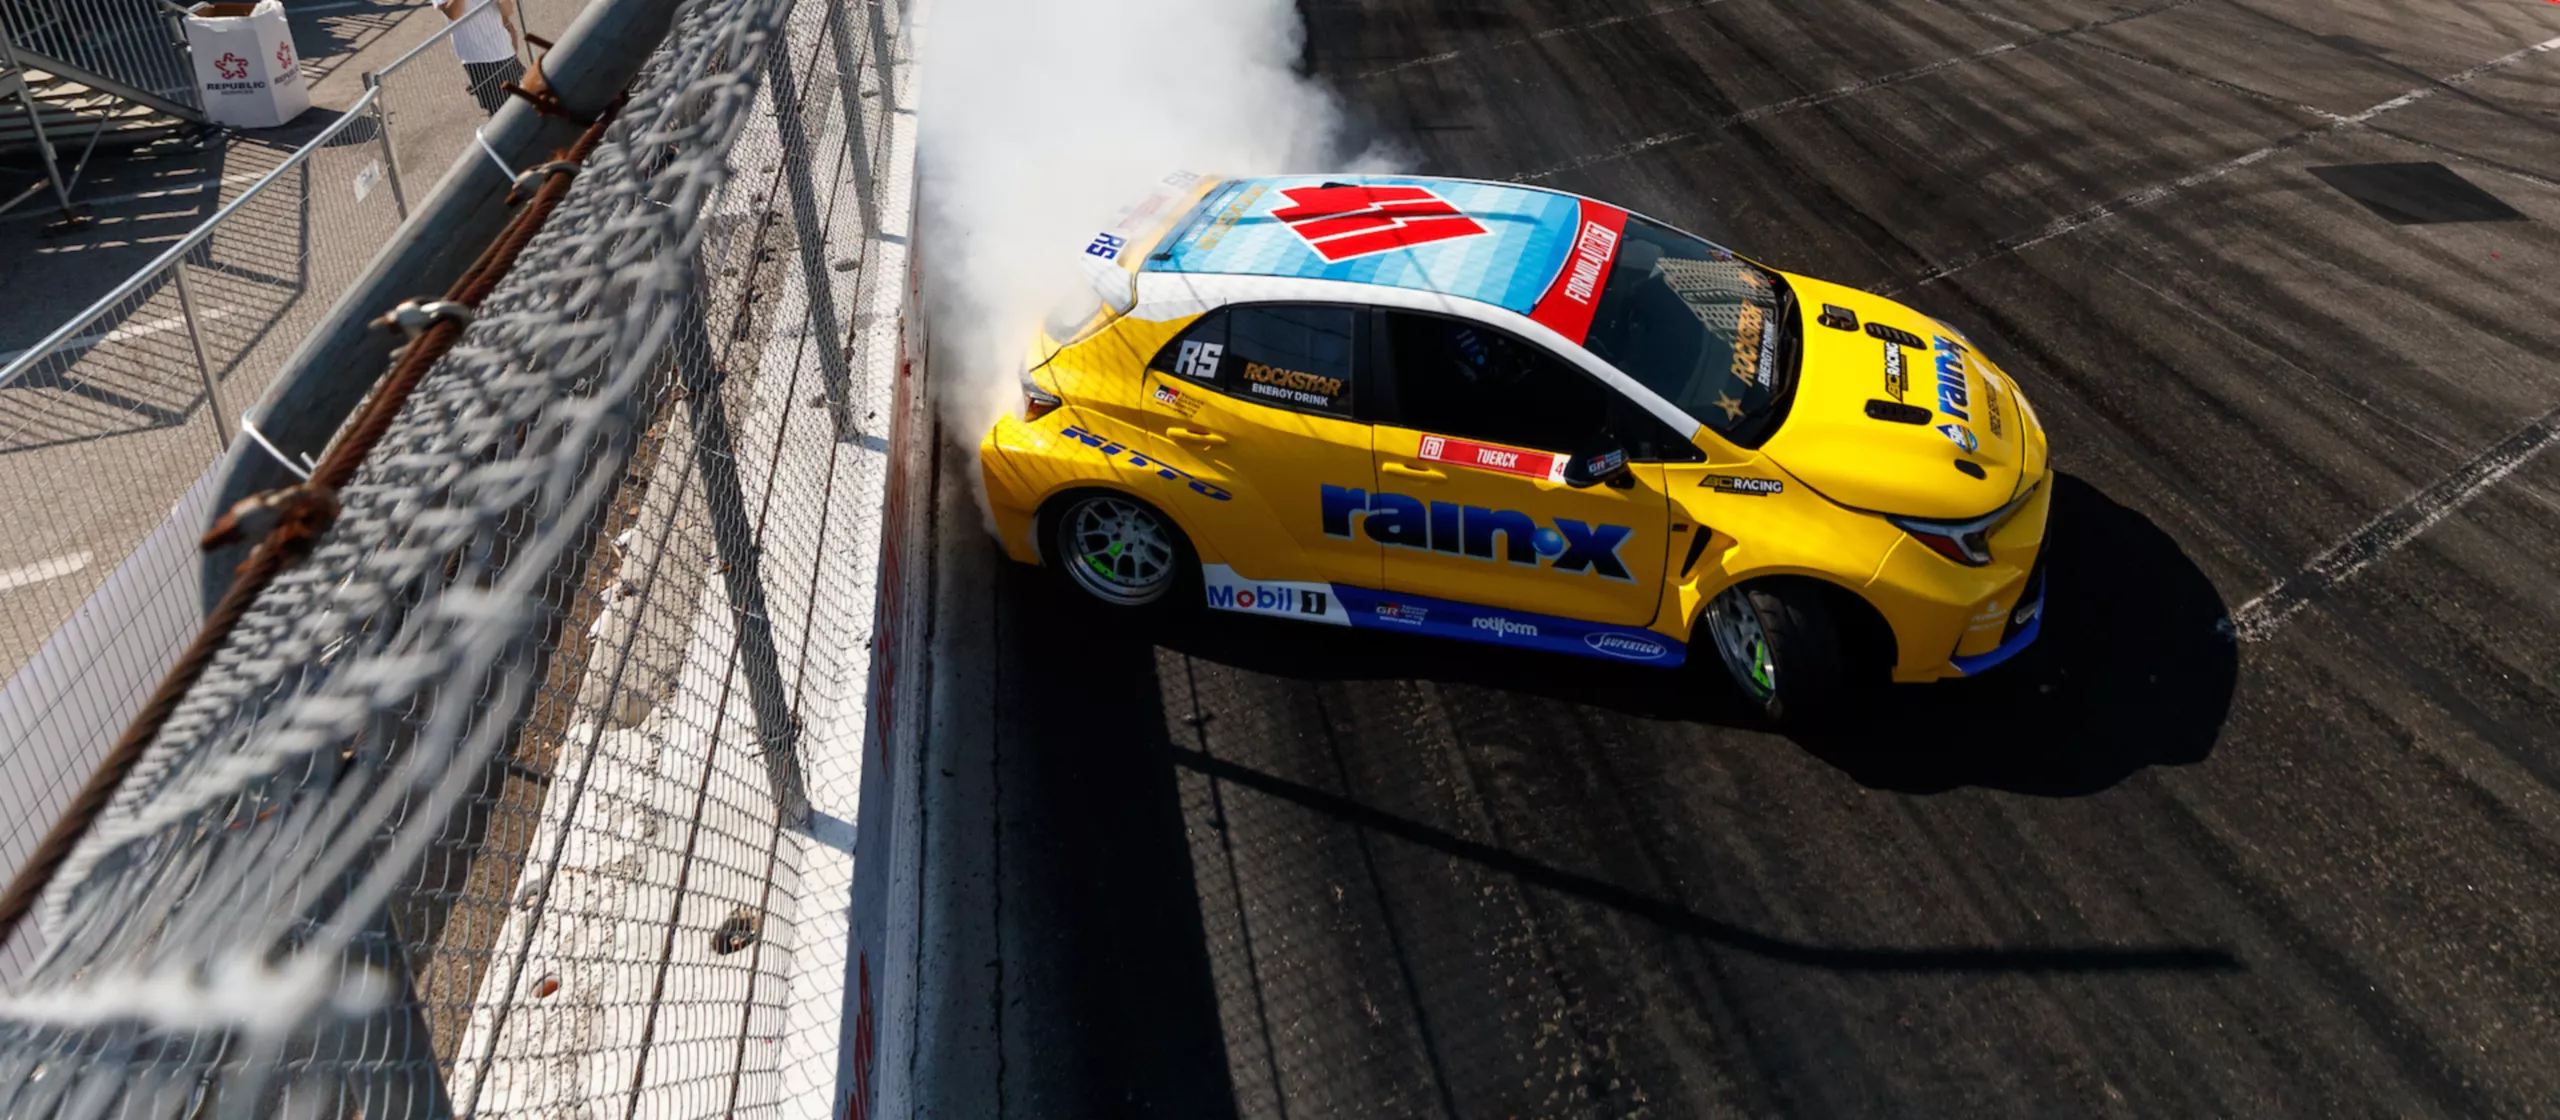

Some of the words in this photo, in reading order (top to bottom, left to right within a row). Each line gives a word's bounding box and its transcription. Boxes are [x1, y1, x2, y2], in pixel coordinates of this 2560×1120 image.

[207, 81, 266, 90] REPUBLIC
[1085, 232, 1128, 260] RS
[1580, 222, 1615, 259] DRIFT
[1564, 249, 1603, 305] FORMULA
[1731, 300, 1762, 387] ROCKSTAR
[1174, 339, 1224, 379] RS
[1758, 344, 1773, 387] ENERGY
[1243, 363, 1343, 396] ROCKSTAR
[1252, 383, 1293, 401] ENERGY
[1294, 391, 1329, 407] DRINK
[1060, 425, 1232, 501] NITTO
[1476, 448, 1519, 469] TUERCK
[1733, 478, 1782, 492] RACING
[1208, 585, 1292, 611] Mobil
[1472, 616, 1538, 637] rotiform
[1603, 636, 1661, 655] SUPERTECH
